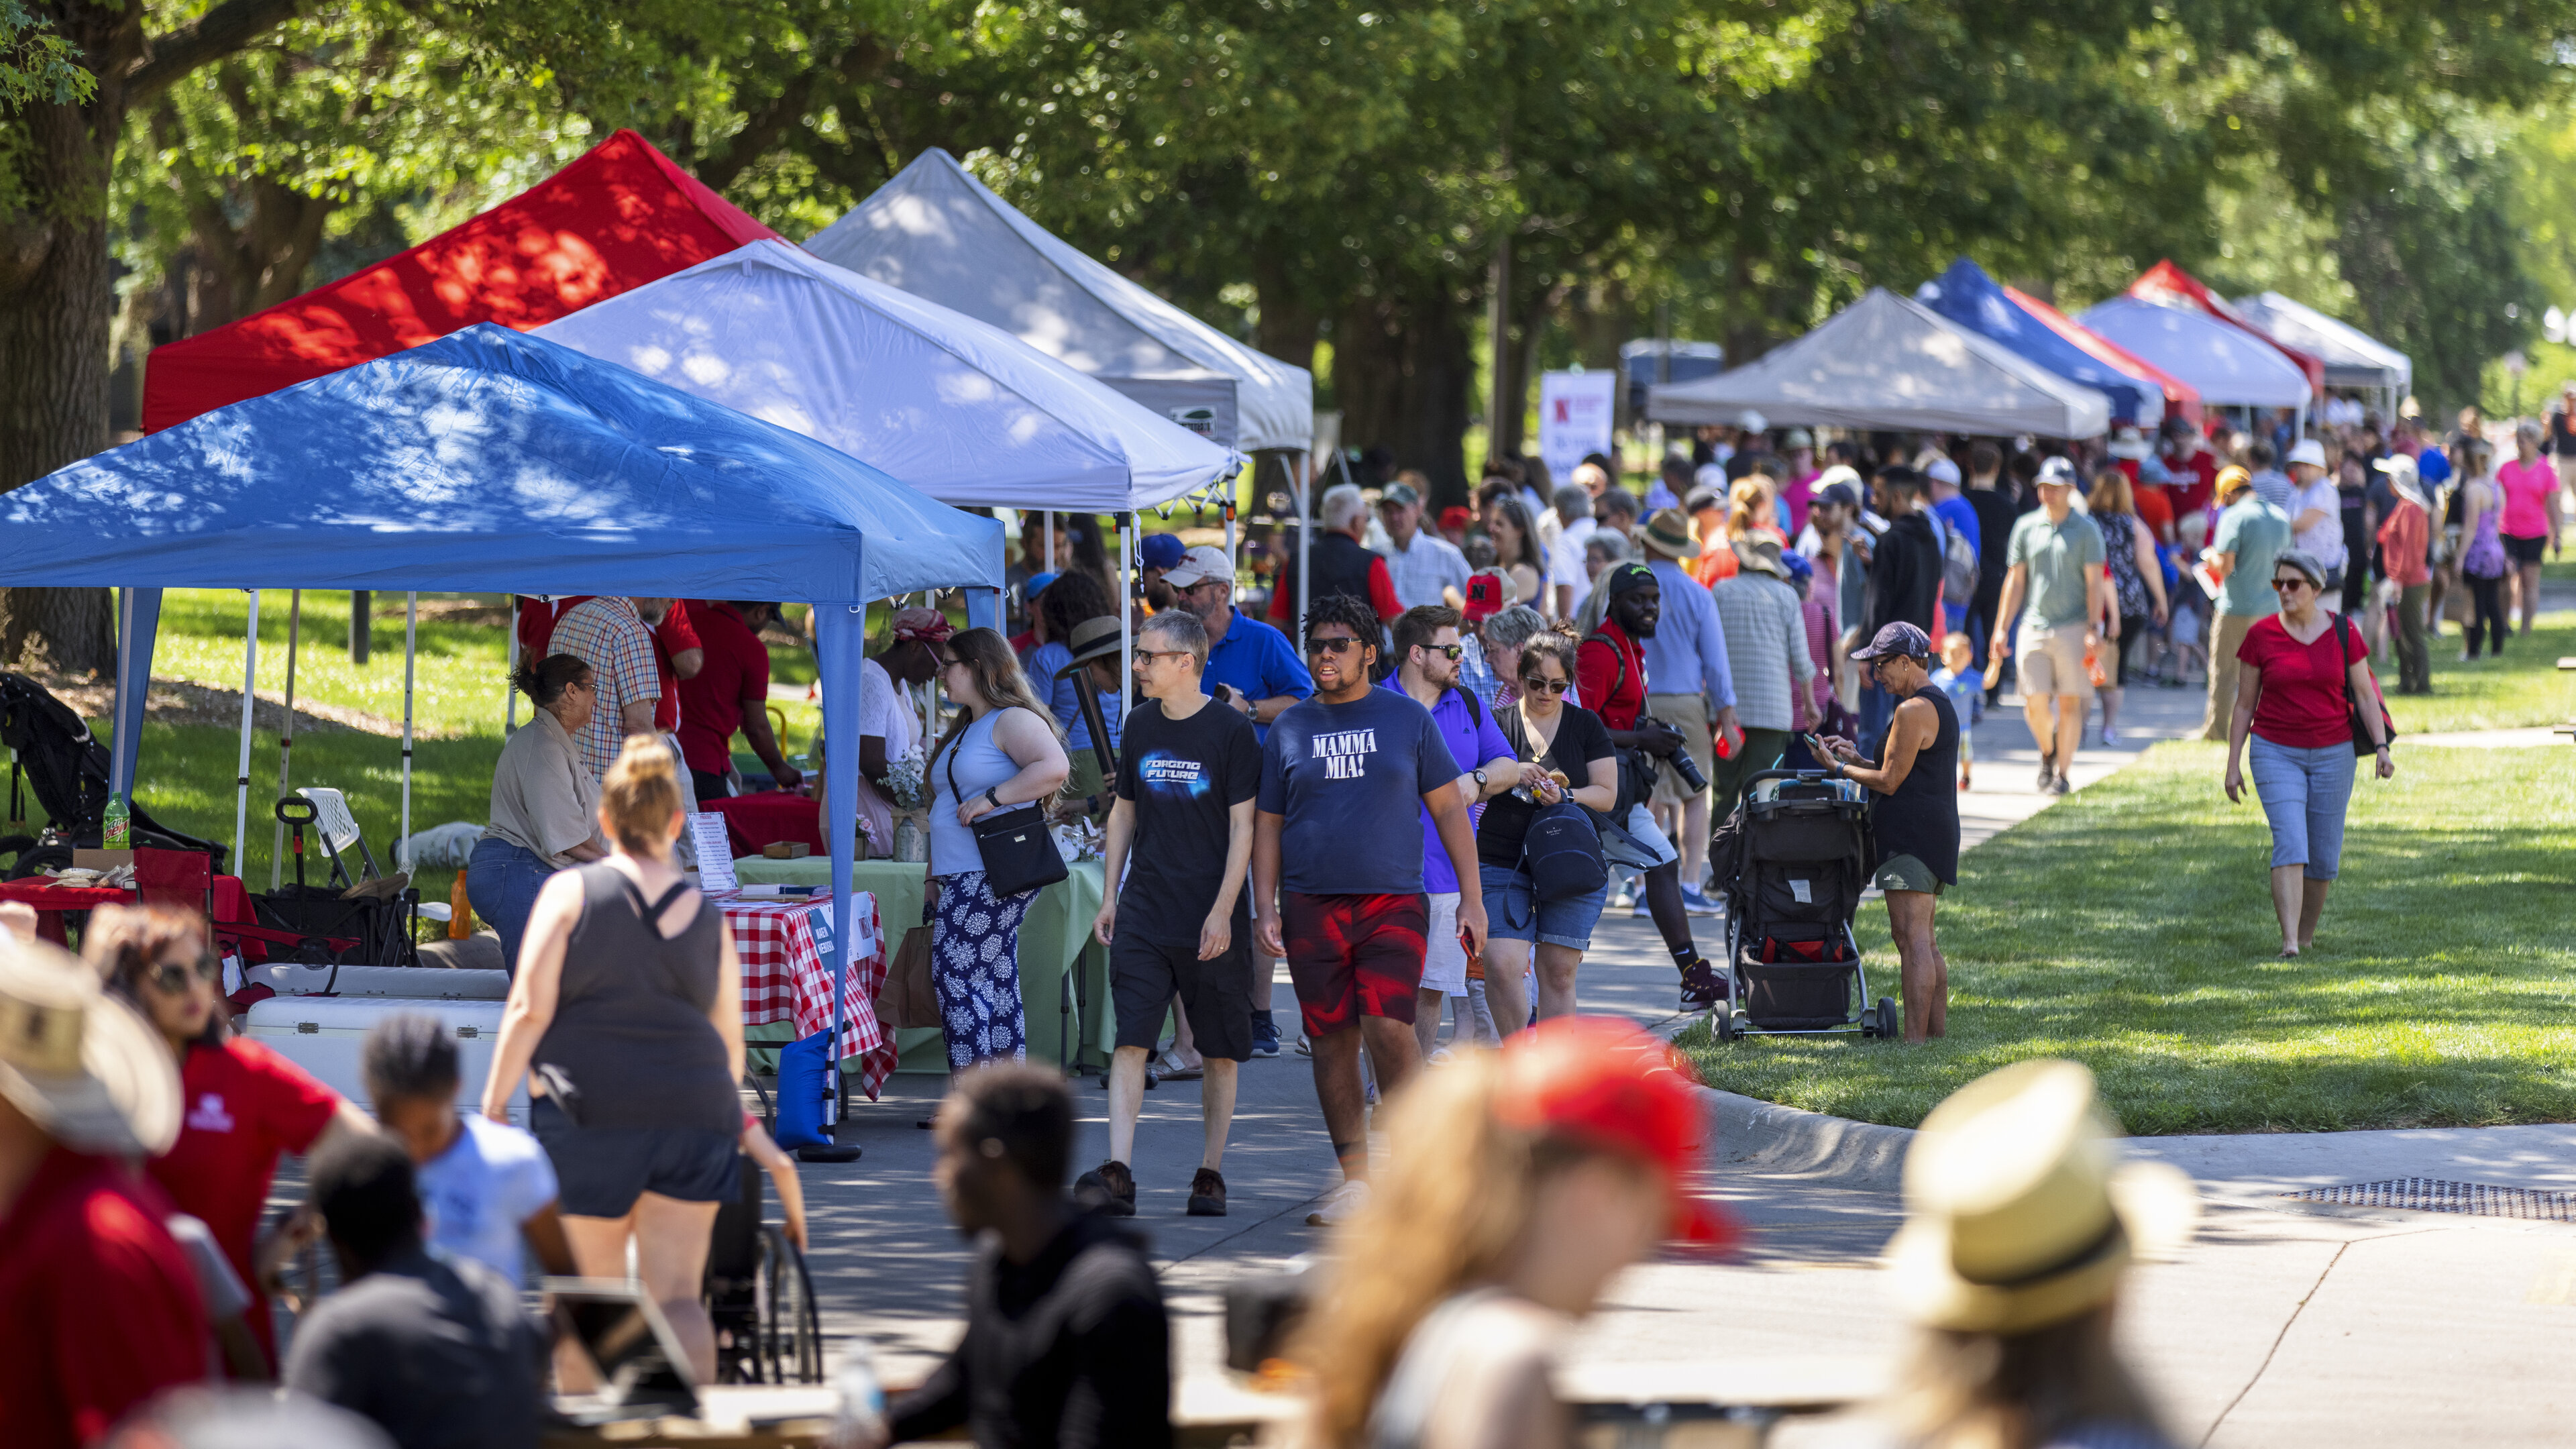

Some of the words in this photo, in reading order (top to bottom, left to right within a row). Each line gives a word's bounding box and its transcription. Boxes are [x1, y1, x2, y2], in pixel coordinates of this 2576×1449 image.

[1471, 584, 1487, 600] N
[1312, 732, 1377, 759] MAMMA
[1145, 760, 1201, 770] FORGING
[1325, 754, 1364, 779] MIA!
[1147, 769, 1199, 780] FUTURE
